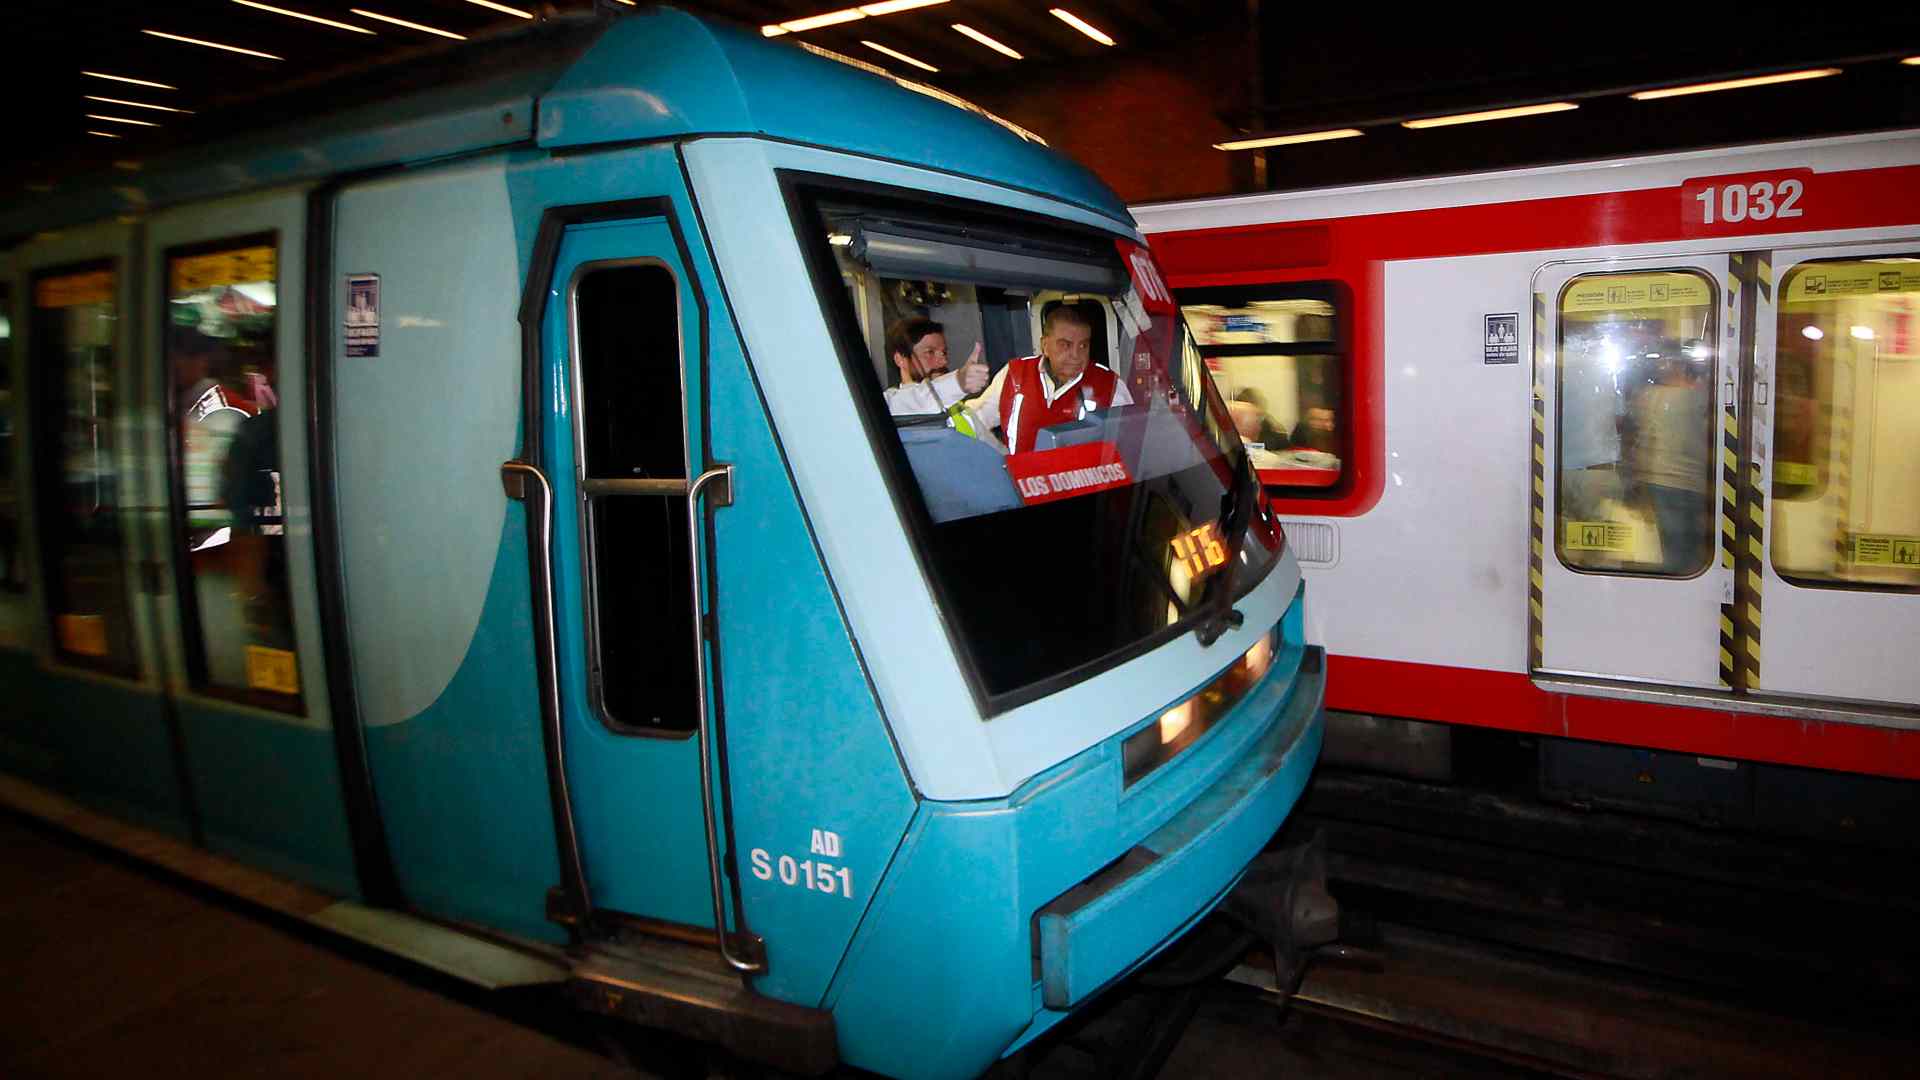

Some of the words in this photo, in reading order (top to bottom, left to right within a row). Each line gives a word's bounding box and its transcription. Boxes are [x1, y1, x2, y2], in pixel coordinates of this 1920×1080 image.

[1696, 179, 1803, 224] 1032
[1018, 476, 1050, 498] LOS
[1048, 463, 1126, 492] DOMINICOS
[810, 828, 840, 857] AD
[751, 848, 772, 880] S
[778, 855, 852, 898] 0151
